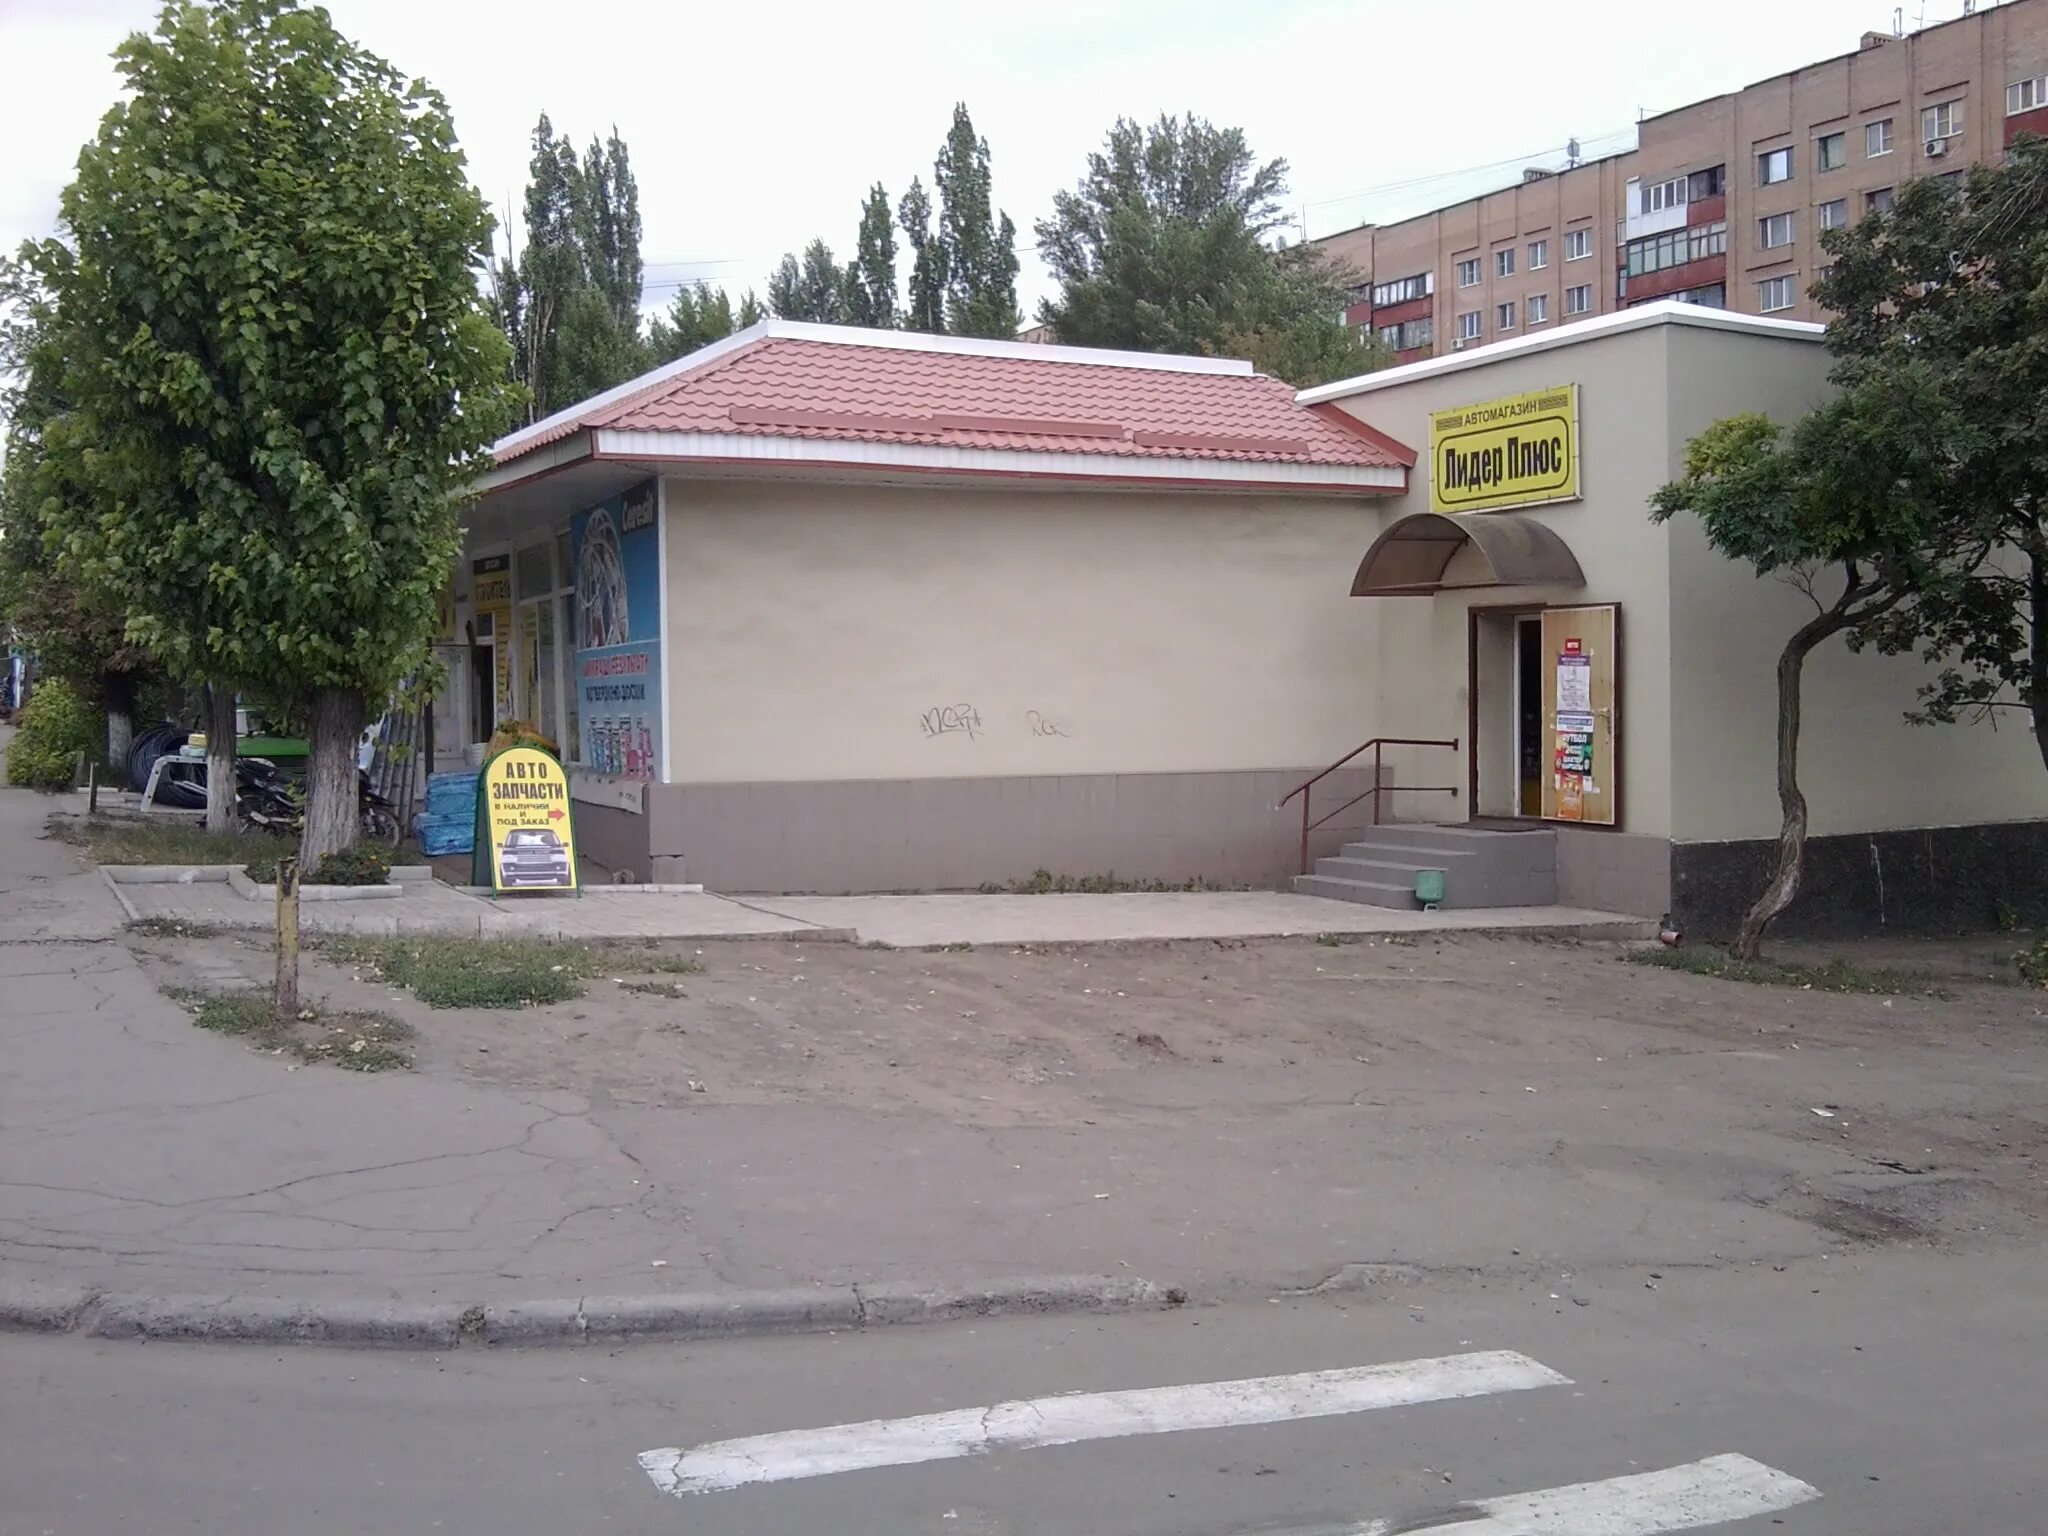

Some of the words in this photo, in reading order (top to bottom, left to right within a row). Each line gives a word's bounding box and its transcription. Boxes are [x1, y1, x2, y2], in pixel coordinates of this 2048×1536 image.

[1464, 400, 1537, 427] АВТОМАГАЗИН
[1445, 446, 1503, 493] Лидер
[1507, 436, 1562, 480] Плюс
[506, 762, 548, 779] АВТО
[493, 783, 564, 800] ЗАПЧАСТИ
[497, 818, 518, 826] ПОД
